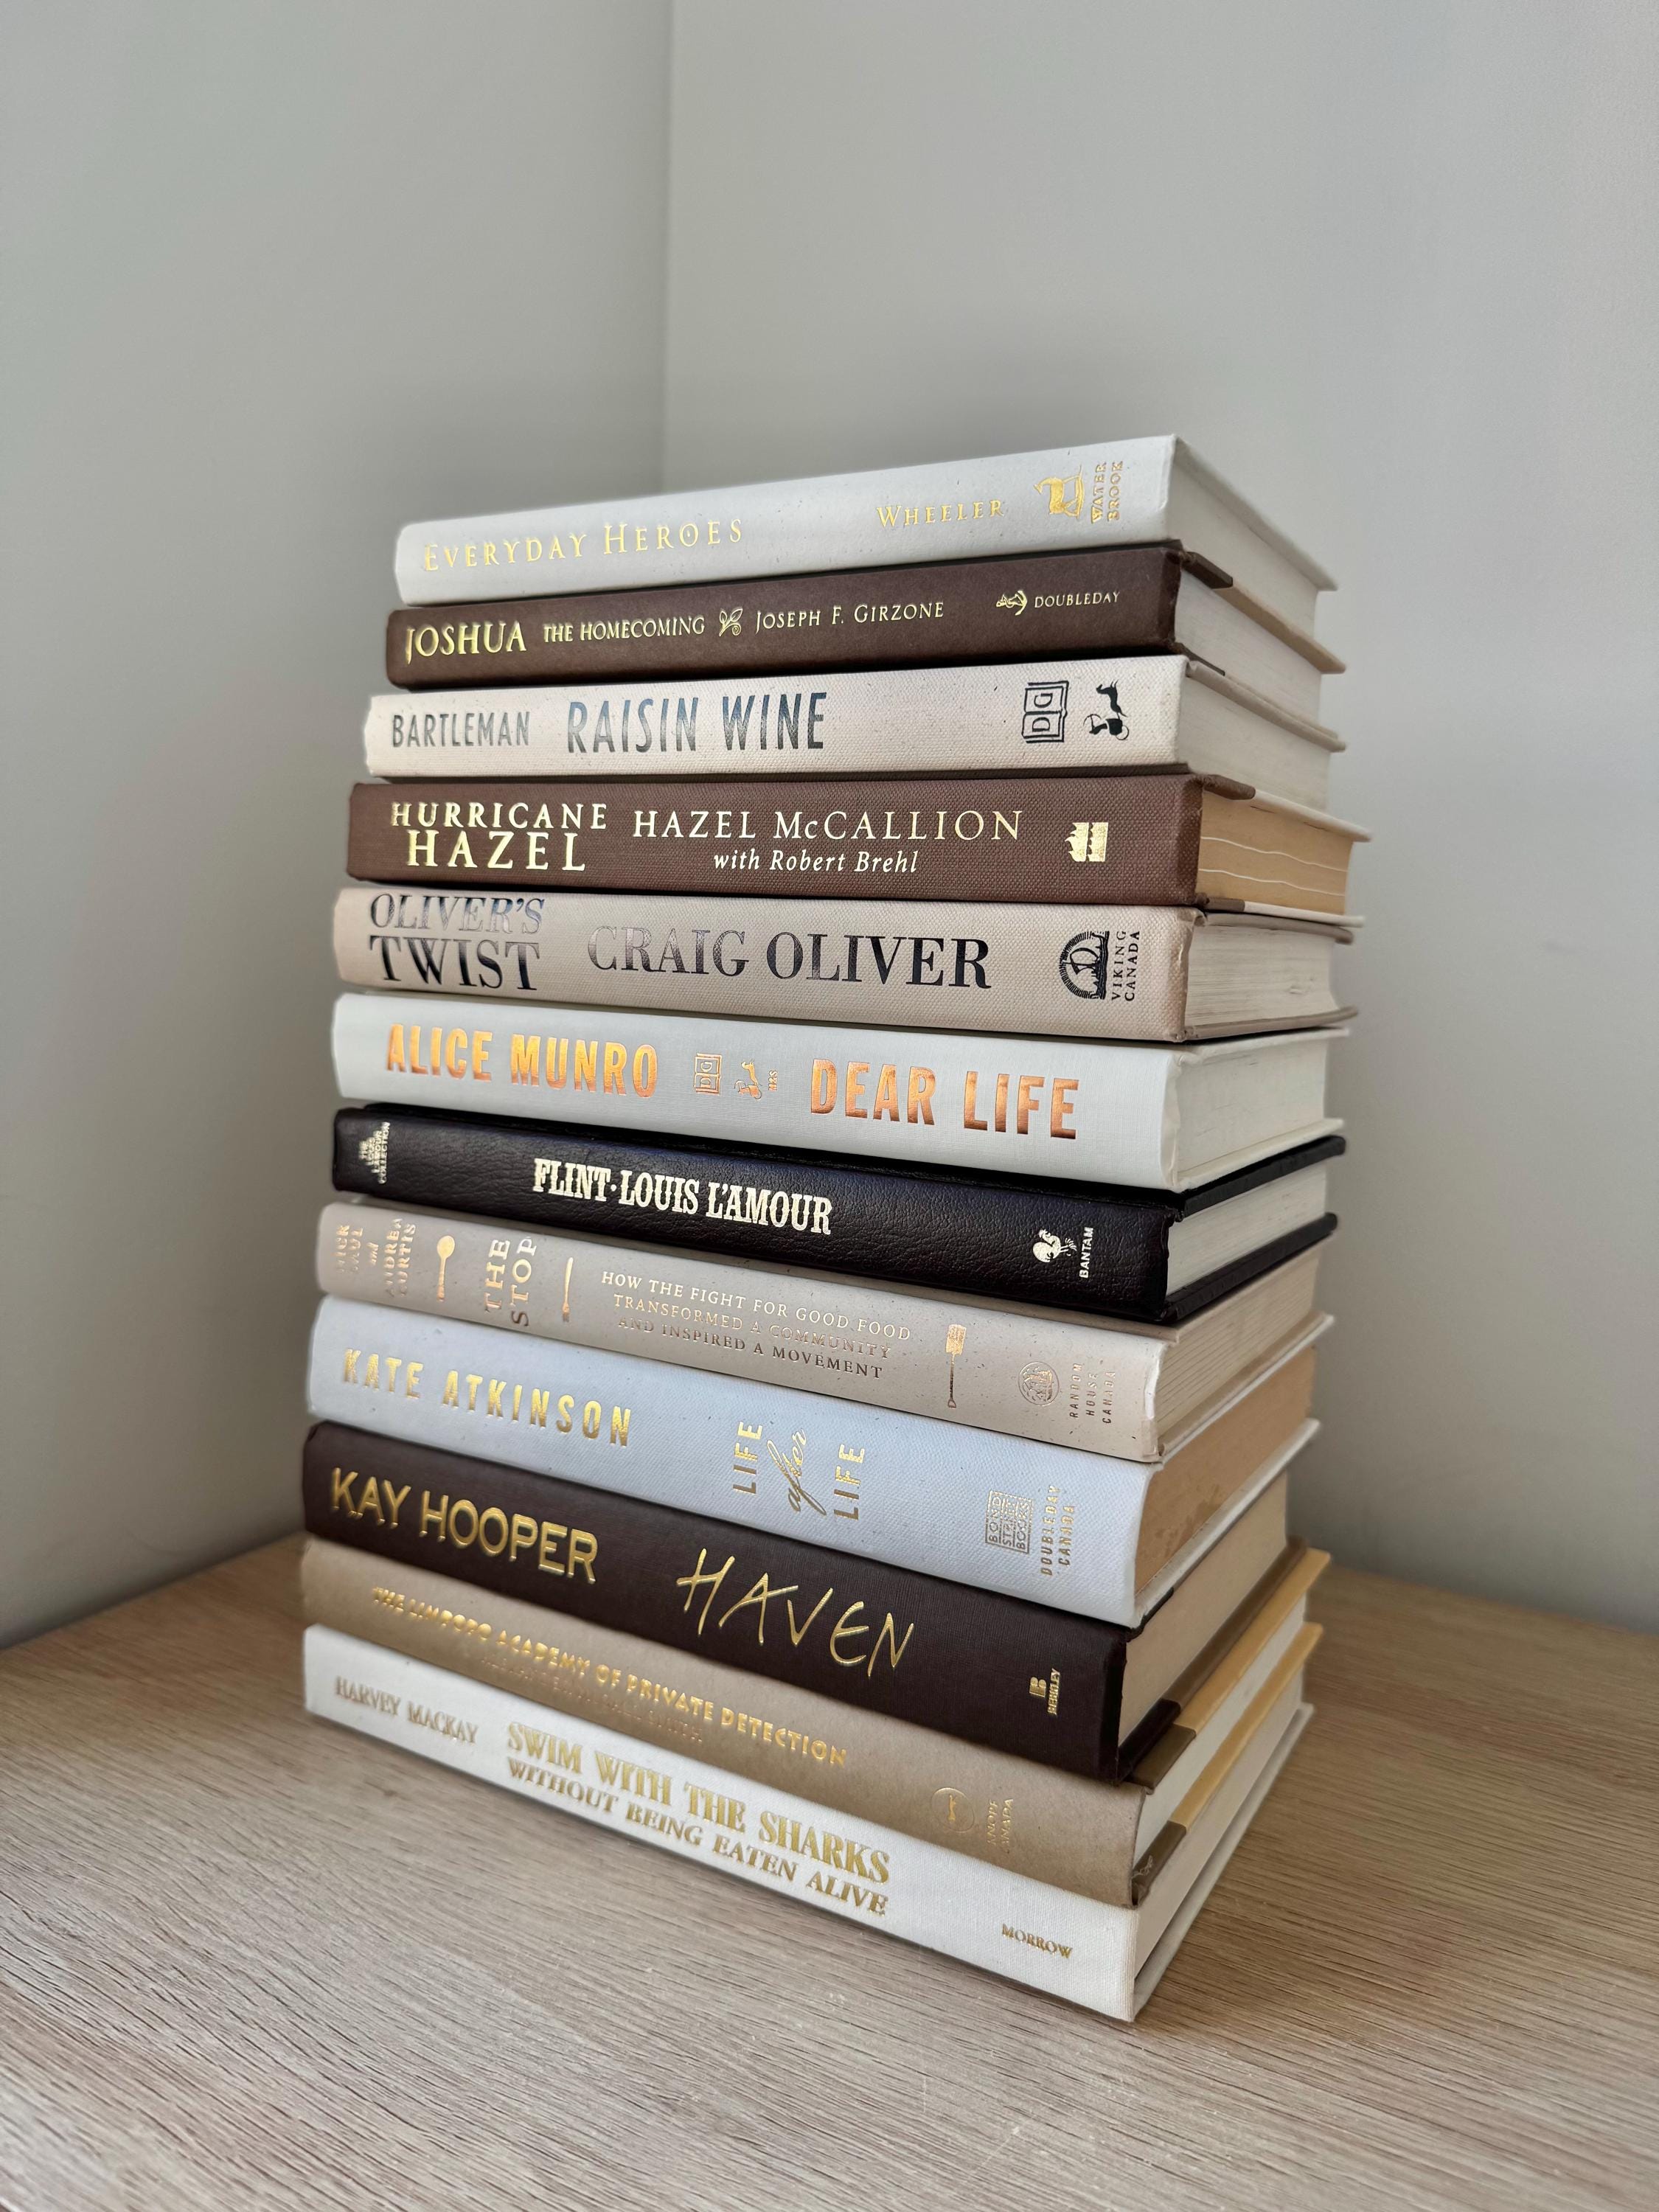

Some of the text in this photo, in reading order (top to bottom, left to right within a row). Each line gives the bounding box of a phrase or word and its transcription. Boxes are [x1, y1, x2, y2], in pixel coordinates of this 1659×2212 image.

[877, 499, 1004, 528] WHEELER
[1091, 461, 1107, 524] WATER
[1107, 460, 1124, 522] BROOK
[424, 518, 743, 571] EVERYDAY HEROES
[756, 602, 944, 635] JOSEPH F. GIRZONE
[1034, 591, 1121, 609] DOUBLEDAY
[405, 616, 705, 664] JOSHUA THE HOMECOMING
[392, 711, 531, 748] BARTLEMAN
[568, 692, 827, 754] RAISIN WINE
[390, 801, 608, 830] HURRICANE
[633, 810, 1023, 841] HAZEL McCALLION
[406, 830, 585, 871] HAZEL
[714, 849, 919, 874] with Robert Brehl
[370, 893, 545, 934] OLIVER'S
[369, 935, 540, 991] TWIST
[588, 925, 992, 990] CRAIG OLIVER
[1112, 930, 1127, 1001] VIKING
[1124, 930, 1141, 1002] CANADA
[386, 1023, 658, 1099] ALICE MUNRO
[810, 1058, 1079, 1140] DEAR LIFE
[378, 1121, 390, 1184] COLLECTION
[706, 1180, 832, 1235] L'AMOUR
[484, 1239, 510, 1312] THE
[510, 1236, 538, 1327] STOP
[1079, 1226, 1094, 1279] BANTAM
[602, 1270, 911, 1341] HOW THE FIGHT FOR GOOD FOOD
[613, 1294, 892, 1360] TRANSFORMED A COMMUNITY
[618, 1315, 883, 1380] AND INSPIRED A MOVEMENT
[344, 1348, 632, 1448] KATE ATKINSON
[1069, 1363, 1082, 1418] RANDOM
[1085, 1373, 1097, 1416] HOUSE
[1102, 1371, 1116, 1424] CANADA
[732, 1421, 763, 1495] LIFE
[767, 1427, 827, 1517] after
[833, 1443, 865, 1522] LIFE
[331, 1467, 599, 1584] KAY HOOPER
[989, 1497, 1001, 1543] BOND
[1016, 1503, 1029, 1550] BOOKS
[1040, 1485, 1060, 1576] DOUBLEDAY
[1058, 1506, 1074, 1566] CANADA
[677, 1548, 915, 1677] HAVEN
[373, 1586, 405, 1613] THE
[496, 1630, 591, 1677] ACADEMY
[596, 1664, 622, 1688] OF
[627, 1674, 714, 1721] PRIVATE
[721, 1706, 847, 1767] DETECTION
[335, 1676, 479, 1745] HARVEY MACKAY
[507, 1722, 891, 1885] SWIM WITH THE SHARKS
[508, 1756, 889, 1918] WITHOUT BEING EATEN ALIVE
[1001, 1922, 1073, 1960] MORROW
